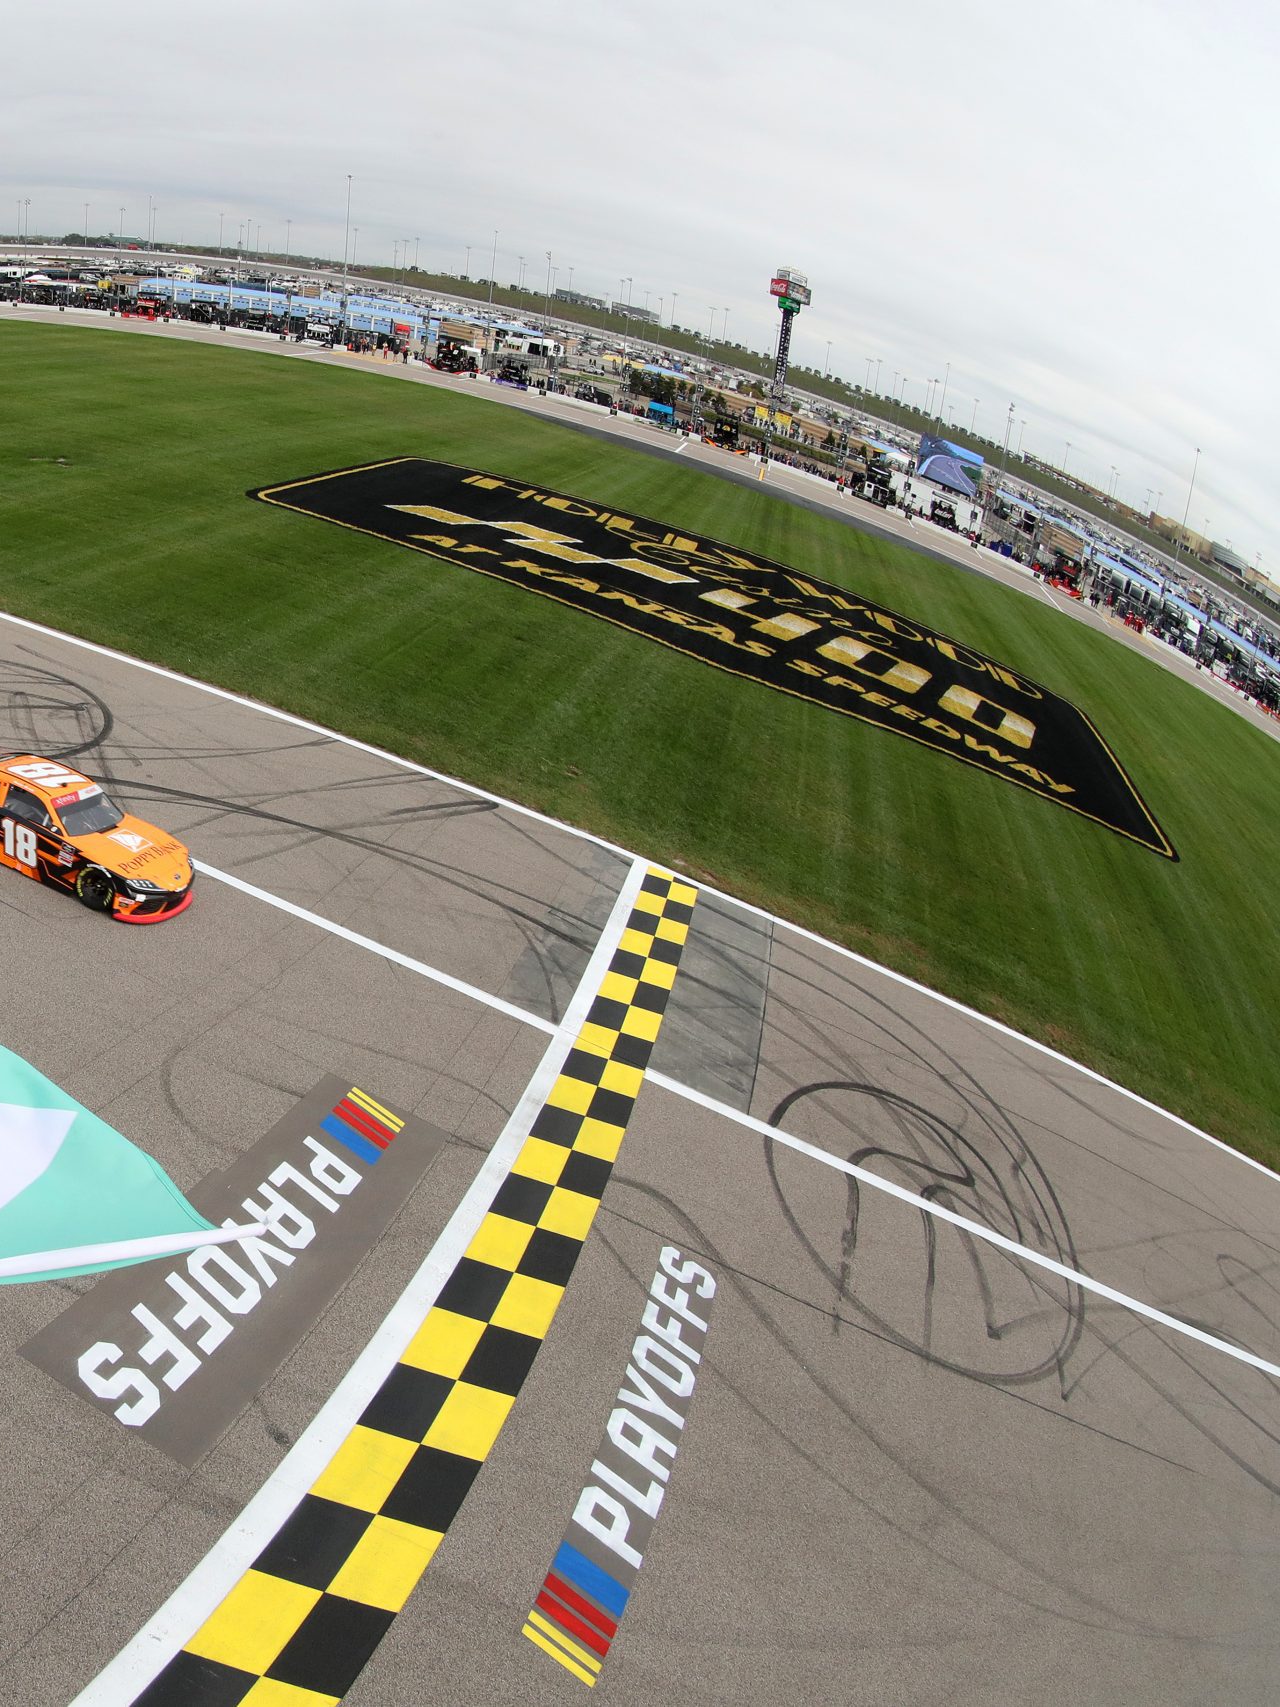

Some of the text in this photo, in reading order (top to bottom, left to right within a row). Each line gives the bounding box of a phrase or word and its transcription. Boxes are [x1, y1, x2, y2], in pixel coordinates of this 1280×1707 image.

[406, 534, 1077, 794] AT KANSAS SPEEDWAY
[698, 588, 1037, 750] 400
[1, 818, 38, 868] 18
[6, 762, 88, 788] 18
[117, 840, 182, 874] POPPY BANK
[77, 1135, 363, 1428] PLAYOFFS
[571, 1246, 717, 1570] PLAYOFFS
